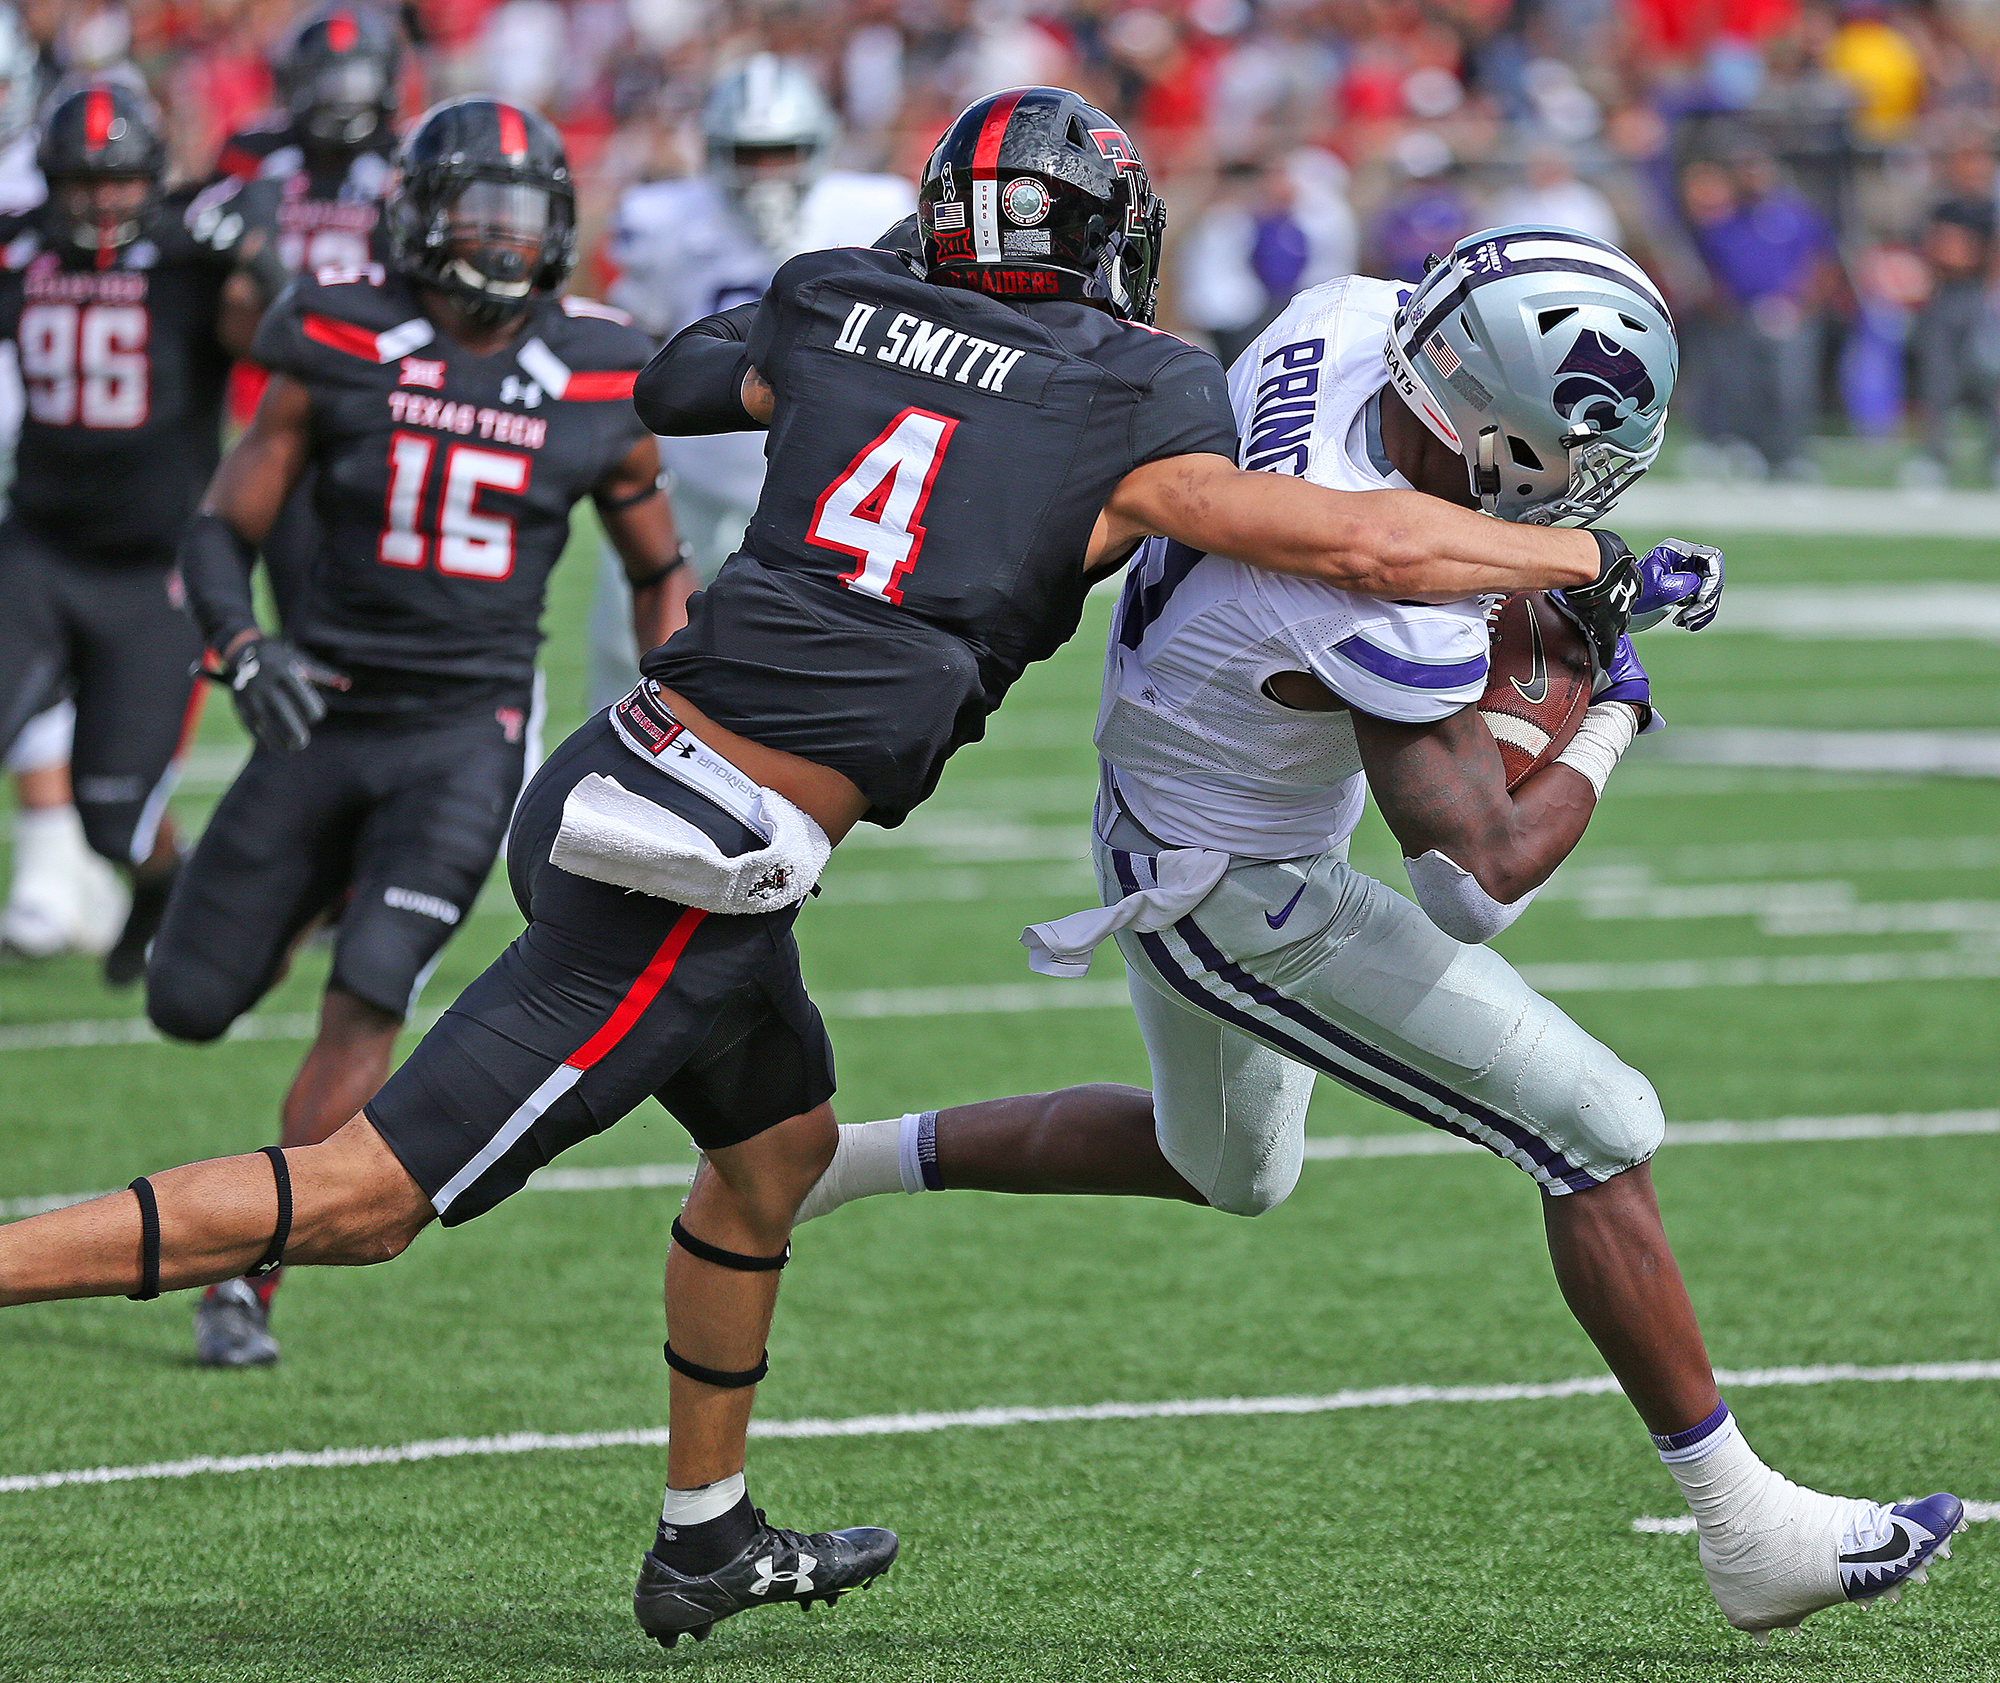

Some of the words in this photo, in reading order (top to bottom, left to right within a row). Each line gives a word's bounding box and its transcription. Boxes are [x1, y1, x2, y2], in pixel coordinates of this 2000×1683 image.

[983, 231, 990, 246] UP
[18, 303, 150, 430] 96
[833, 301, 875, 355] D.
[876, 312, 1027, 393] SMITH
[388, 390, 476, 436] TEXAS
[477, 407, 548, 450] TECH
[804, 406, 961, 606] 4
